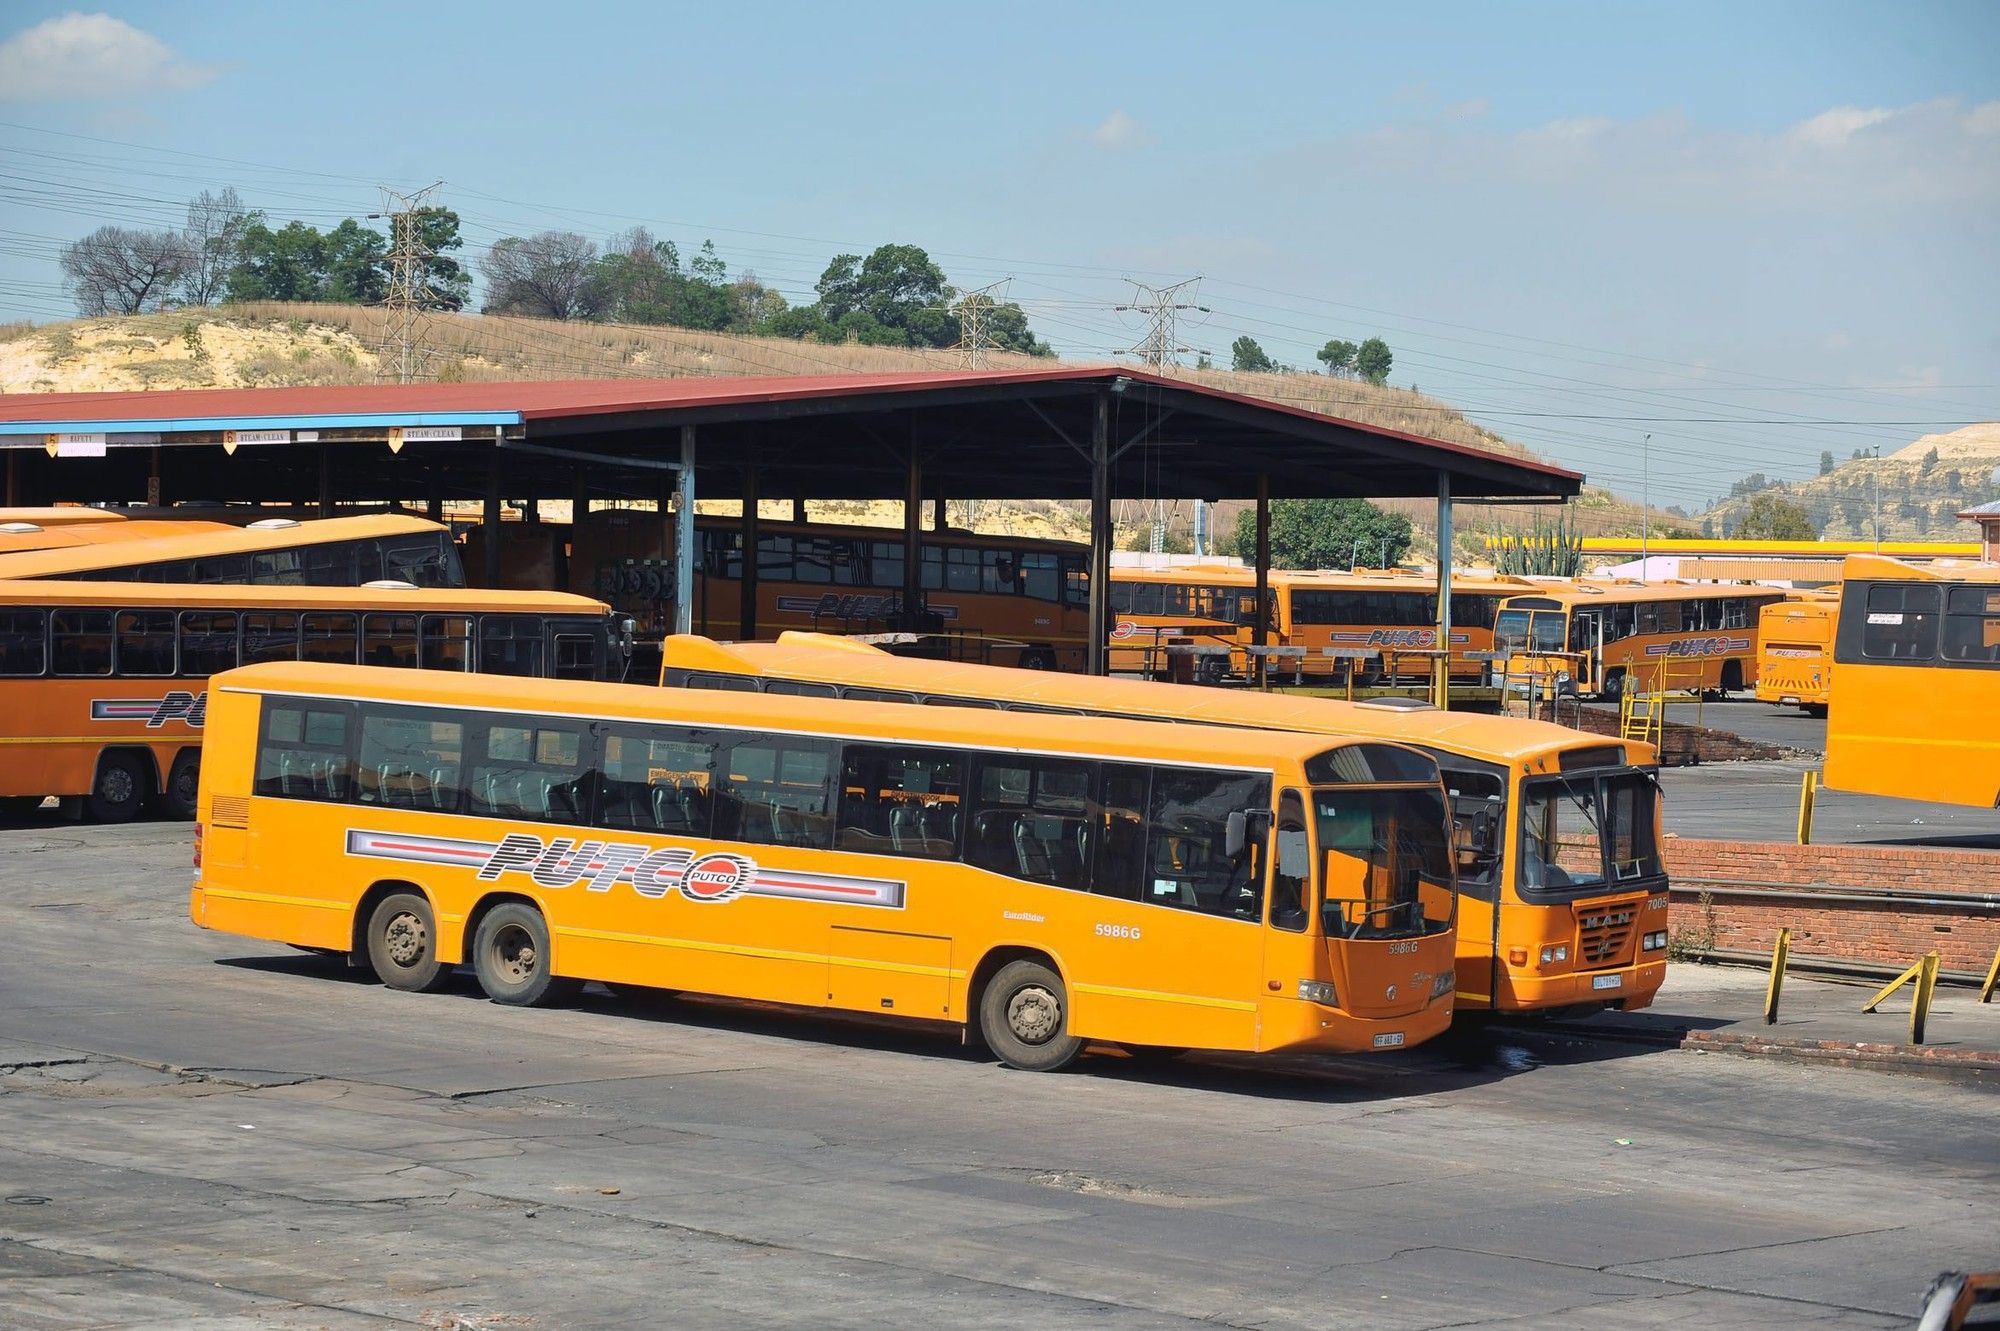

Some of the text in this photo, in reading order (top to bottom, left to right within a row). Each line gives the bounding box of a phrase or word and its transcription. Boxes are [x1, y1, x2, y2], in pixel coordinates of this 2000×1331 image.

[226, 431, 233, 443] 6
[393, 427, 400, 441] 7
[476, 832, 754, 903] PUTCO
[691, 871, 737, 884] PUTCO
[1647, 897, 1668, 911] 7005
[1586, 912, 1630, 929] MAN
